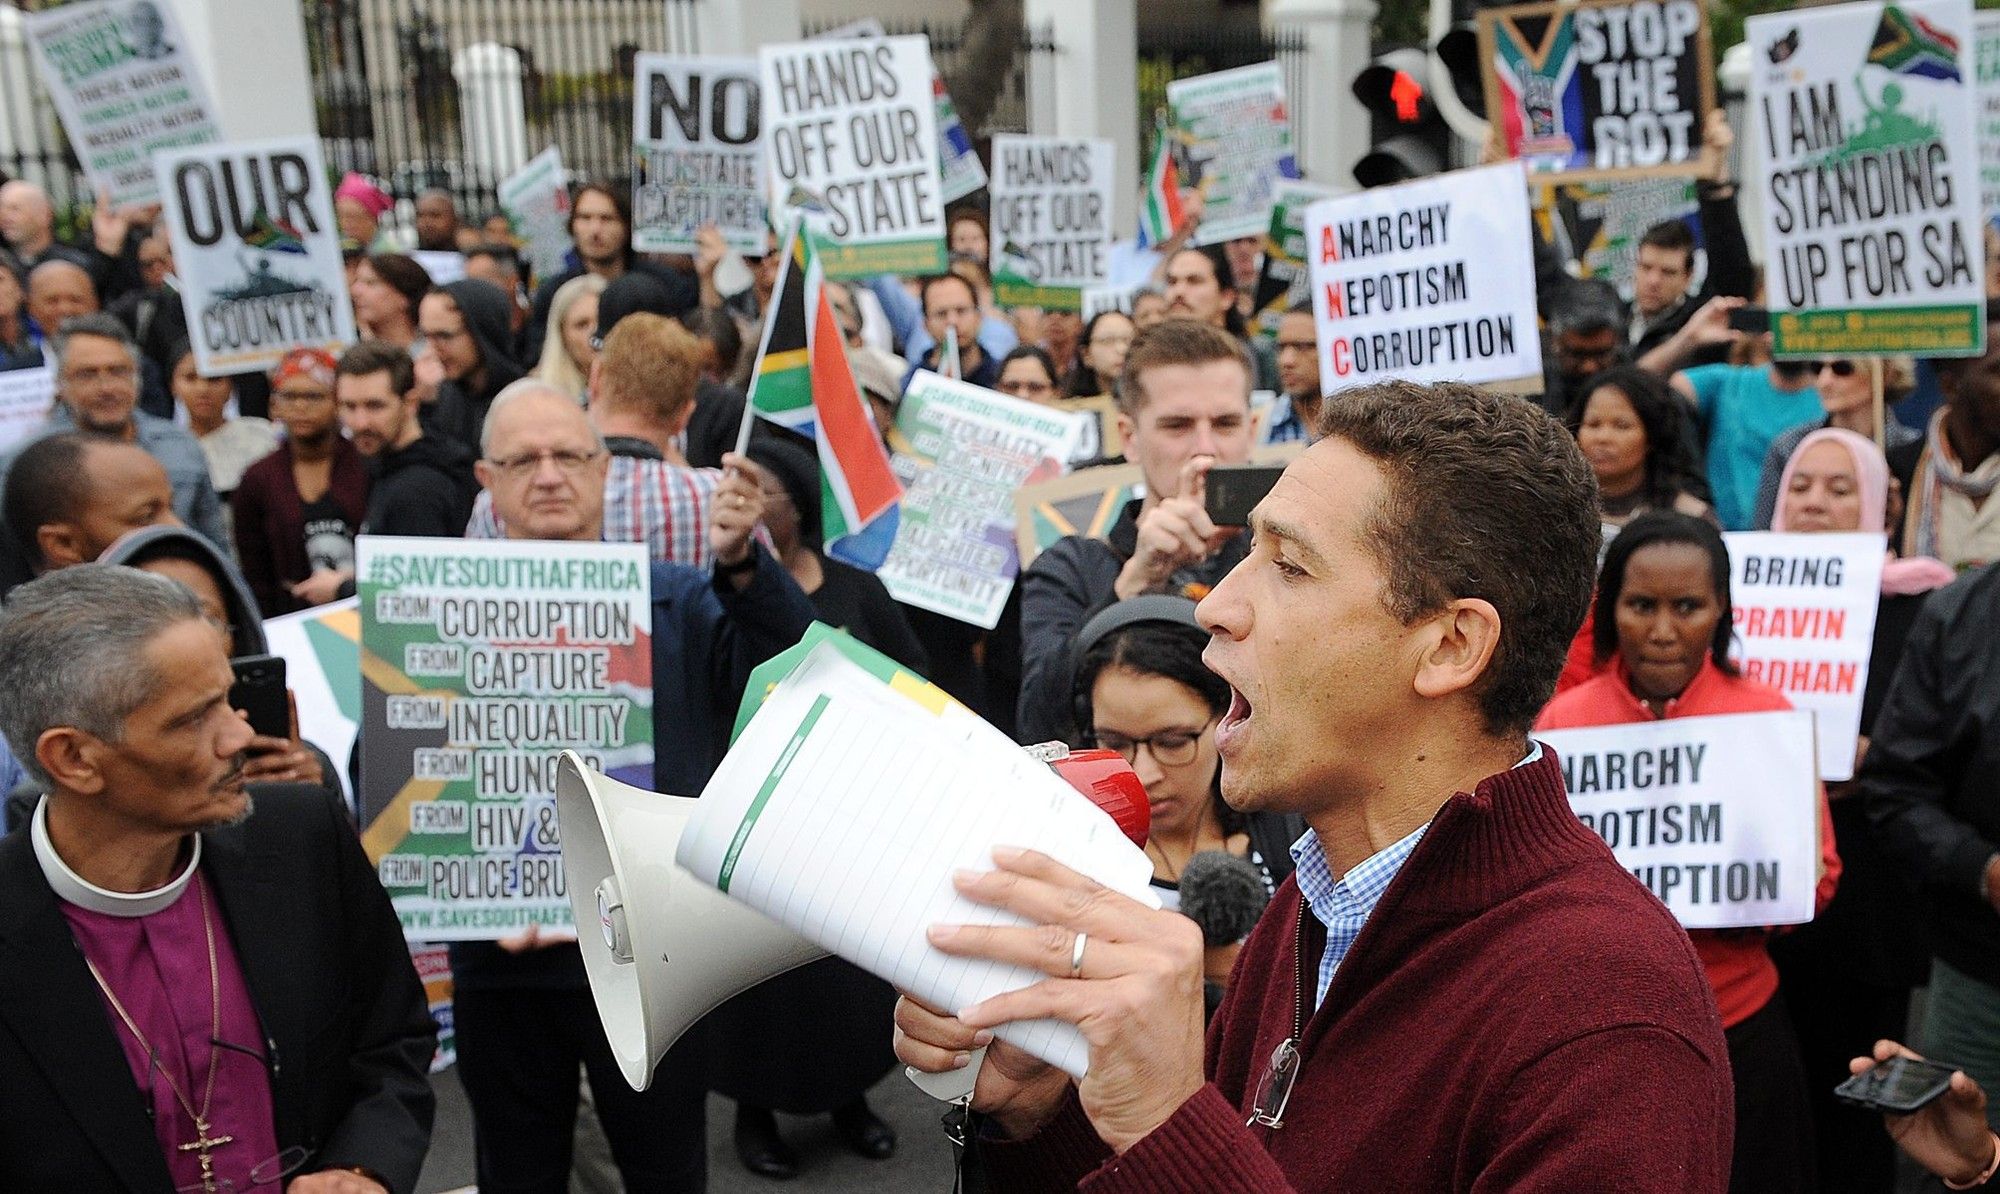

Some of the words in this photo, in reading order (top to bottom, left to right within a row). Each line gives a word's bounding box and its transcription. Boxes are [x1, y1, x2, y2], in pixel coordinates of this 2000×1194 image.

[1574, 2, 1699, 63] STOP
[651, 73, 760, 144] NO
[775, 46, 898, 114] HANDS
[1592, 56, 1681, 115] THE
[774, 120, 837, 180] OFF
[851, 109, 925, 168] OUR
[1593, 110, 1695, 170] ROT
[1764, 95, 1776, 159] I
[1790, 81, 1845, 155] AM
[1003, 144, 1092, 185] HANDS
[1771, 142, 1954, 234] STANDING
[176, 153, 319, 246] OUR
[826, 171, 936, 238] STATE
[1000, 194, 1041, 234] OFF
[1052, 192, 1103, 232] OUR
[1028, 239, 1104, 280] STATE
[1321, 202, 1450, 265] ANARCHY
[1325, 262, 1468, 321] NEPOTISM
[1781, 242, 1828, 308] UP
[1840, 230, 1913, 300] FOR
[1921, 220, 1974, 289] SA
[202, 293, 337, 350] COUNTRY
[1333, 315, 1516, 377] CORRUPTION
[371, 555, 642, 591] #SAVESOUTHAFRICA
[1742, 555, 1845, 588] BRING
[443, 599, 630, 639] CORRUPTION
[472, 651, 606, 690] CAPTURE
[1728, 658, 1857, 693] RDHAN
[454, 703, 625, 749] INEQUALITY
[477, 807, 525, 846] HIV
[537, 806, 560, 845] &
[432, 860, 512, 900] POLICE
